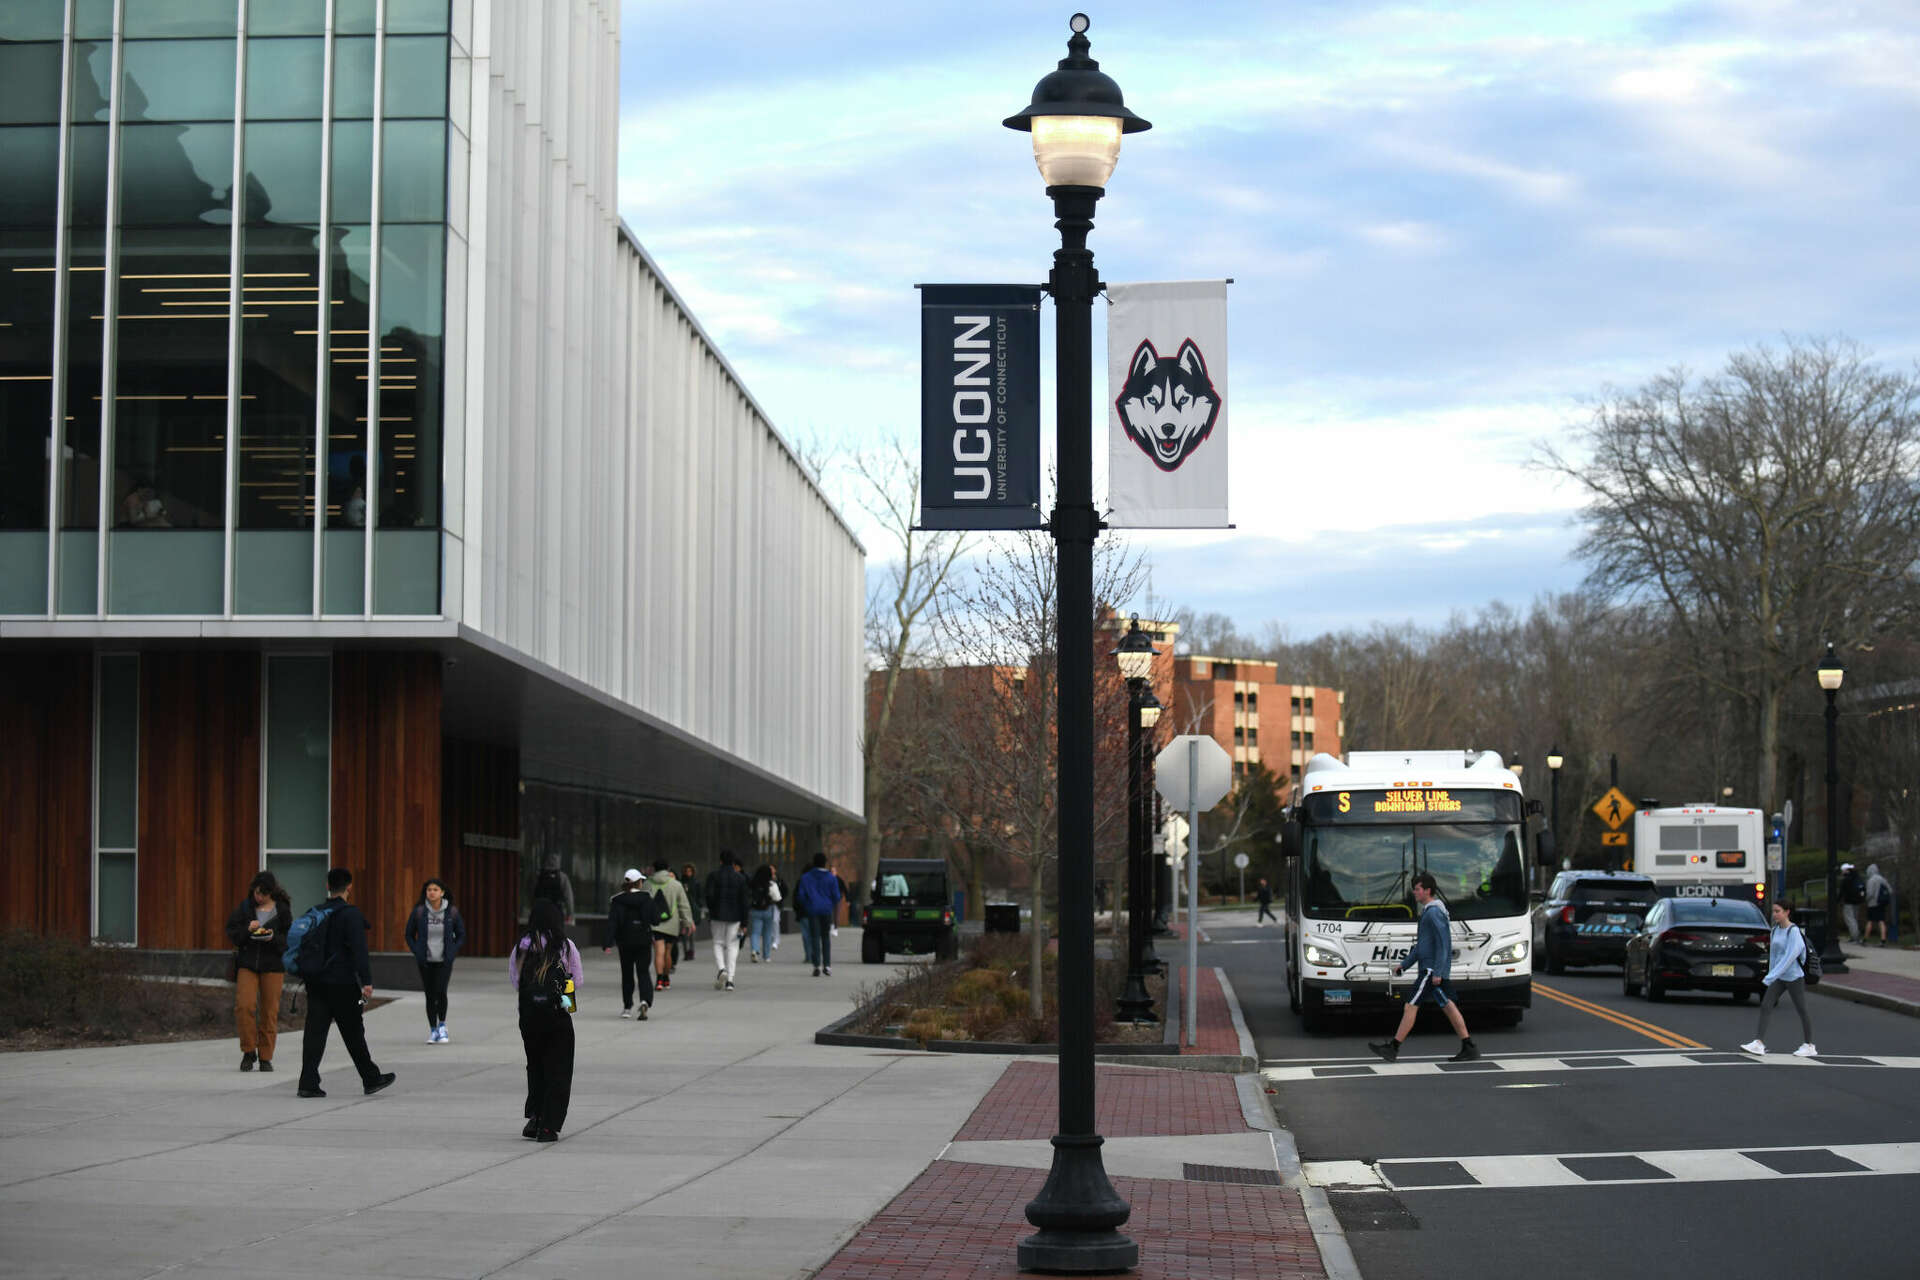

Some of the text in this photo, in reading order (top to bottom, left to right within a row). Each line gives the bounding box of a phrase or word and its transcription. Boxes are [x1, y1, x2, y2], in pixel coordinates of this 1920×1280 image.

[953, 316, 992, 500] UCONN
[997, 316, 1007, 501] UNIVERSITY OF CONNECTICUT
[1385, 790, 1450, 801] SILVER LINE
[1338, 791, 1352, 813] S
[1374, 800, 1462, 812] DOWNTOWN STORRS
[1675, 885, 1725, 897] UCONN
[1316, 922, 1342, 934] 1704
